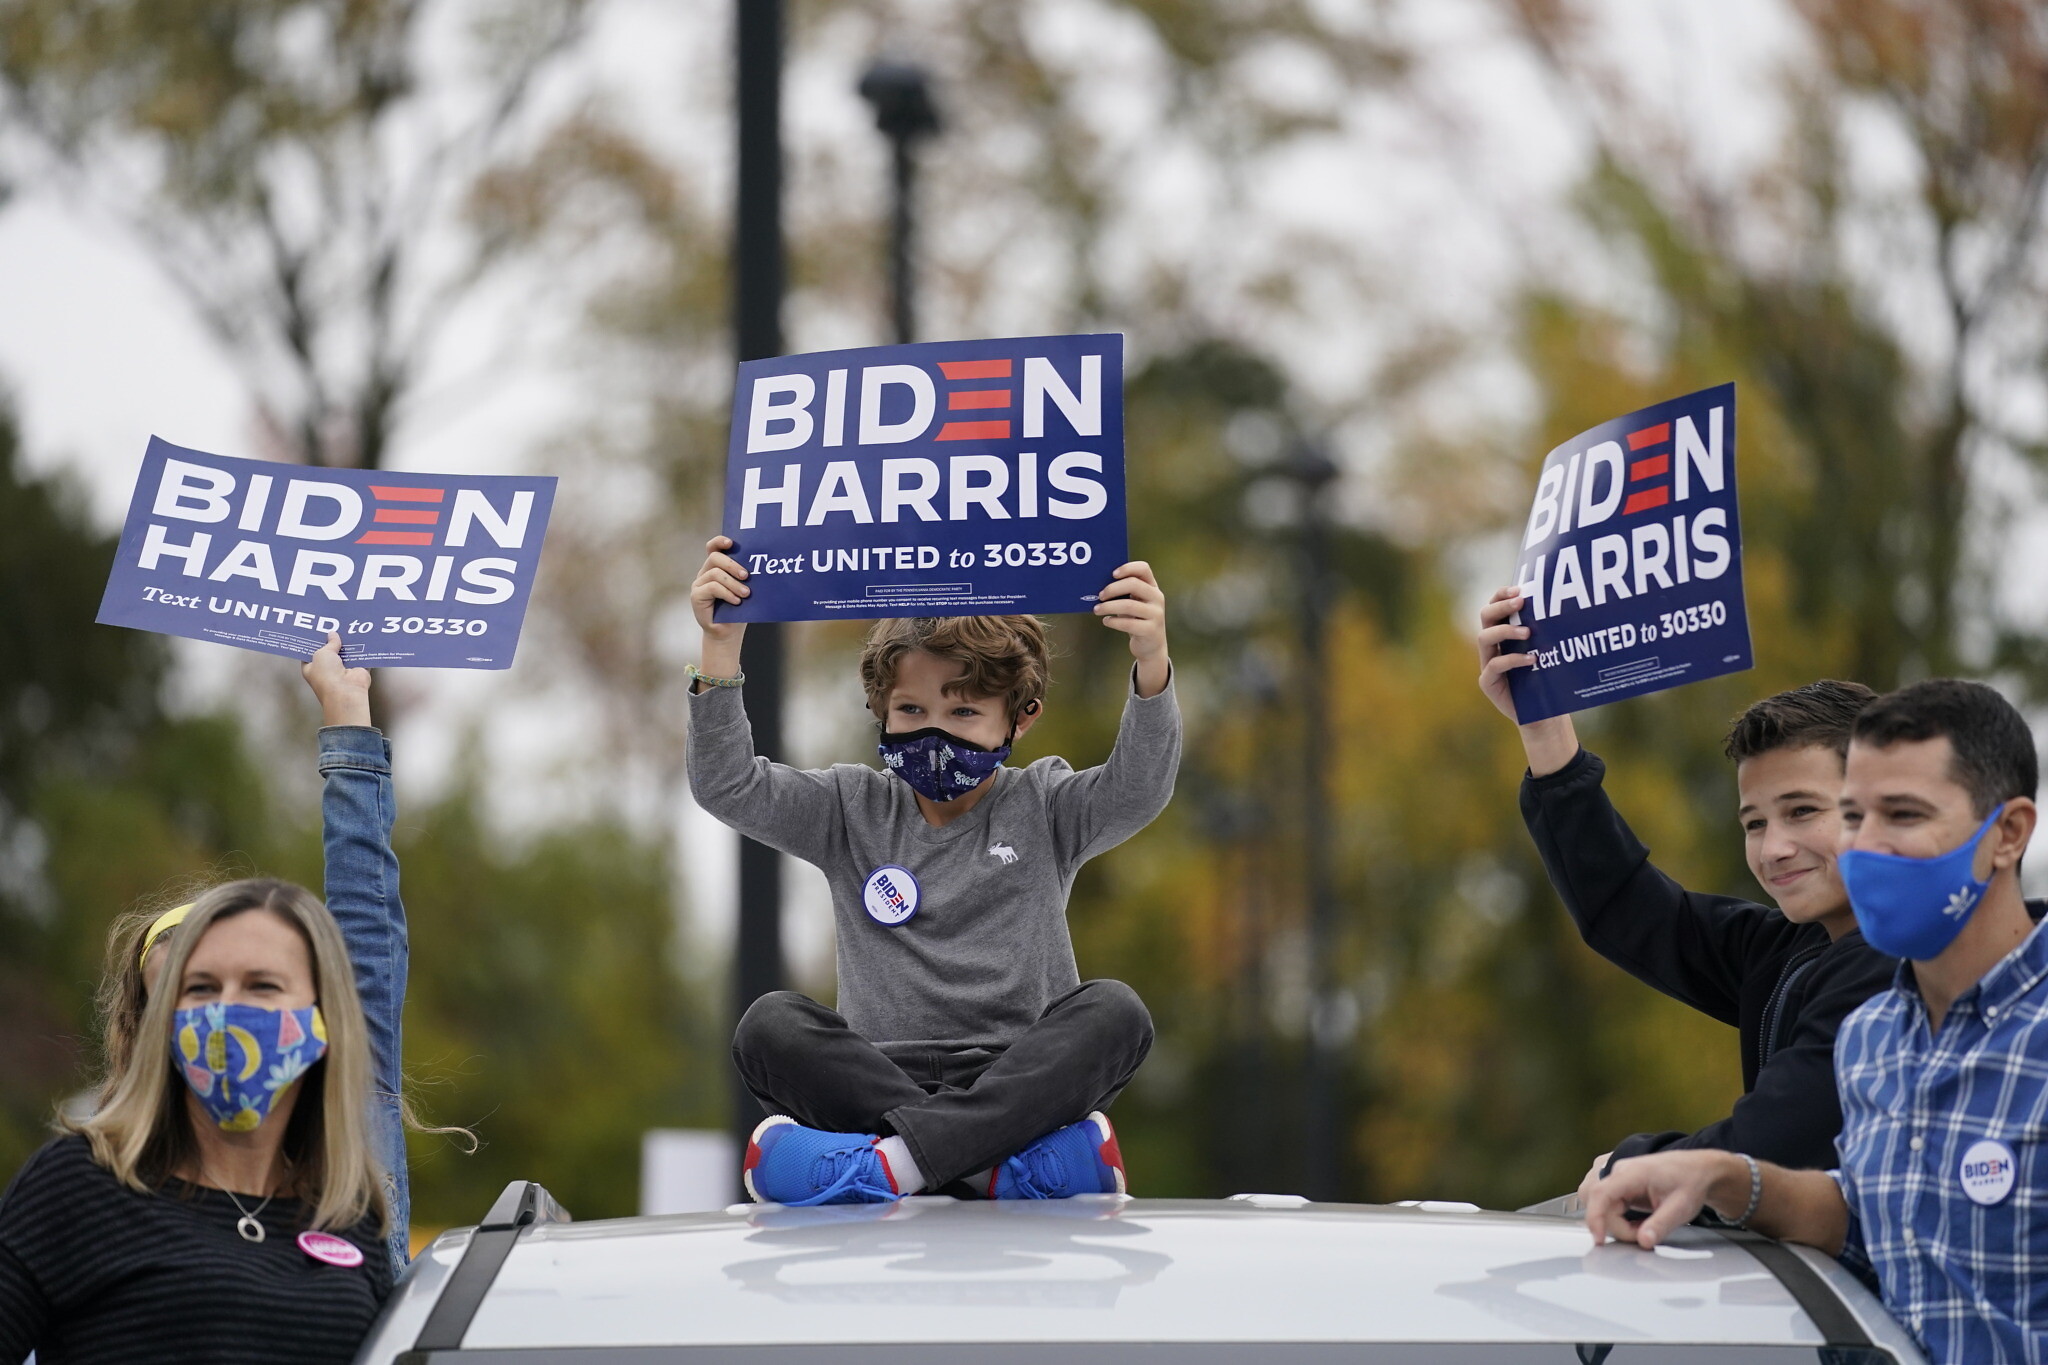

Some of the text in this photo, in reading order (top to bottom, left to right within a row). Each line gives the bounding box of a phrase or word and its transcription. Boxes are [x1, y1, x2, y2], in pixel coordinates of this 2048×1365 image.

[747, 354, 1102, 454] BIDEN
[152, 458, 536, 549] BIDEN
[739, 451, 1108, 529] HARRIS
[1525, 406, 1725, 550] BIDEN
[137, 524, 517, 605] HARRIS
[748, 541, 1092, 576] Text UNITED to 30330
[1510, 507, 1731, 626] HARRIS
[142, 586, 488, 637] Text UNITED to 30330
[1559, 623, 1637, 663] UNITED
[1640, 624, 1658, 645] to
[1659, 600, 1727, 639] 30330
[872, 882, 899, 917] PRESIDENT
[876, 874, 910, 914] BIDEN
[1965, 1158, 2009, 1178] BIDEN
